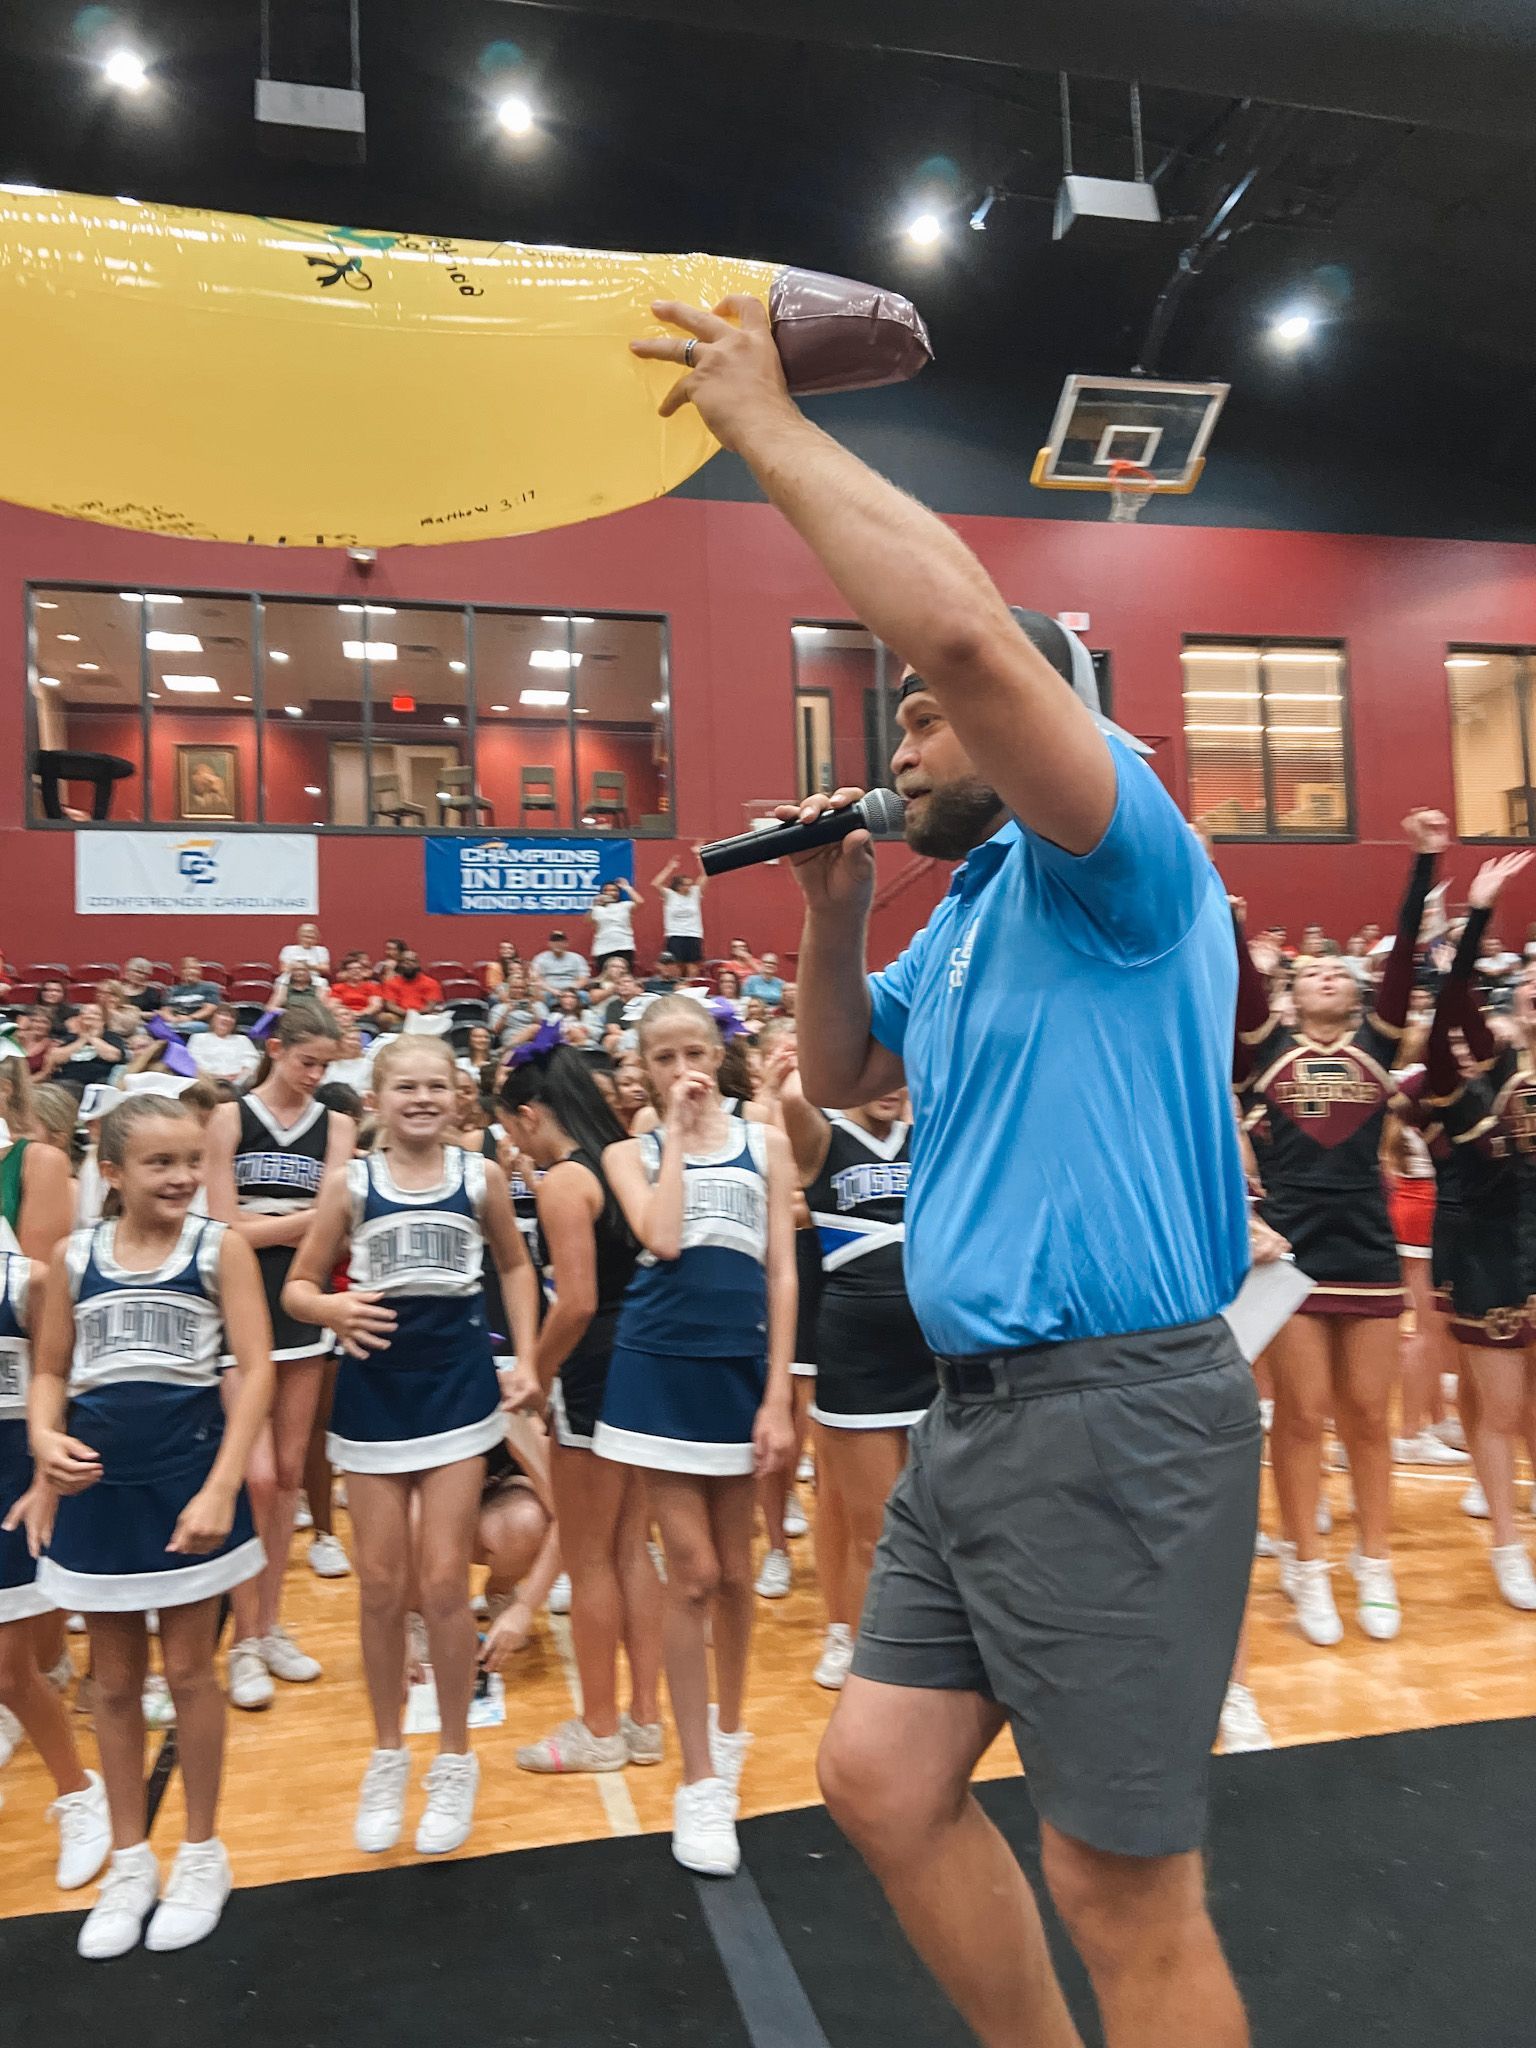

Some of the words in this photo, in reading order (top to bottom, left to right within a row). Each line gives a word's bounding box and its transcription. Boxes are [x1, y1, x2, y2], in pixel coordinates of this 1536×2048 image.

[460, 848, 600, 865] CHAMPIONS
[460, 868, 500, 890] IN
[87, 896, 206, 908] CONFERENCE
[209, 897, 308, 909] CAROLINAS
[461, 895, 521, 910] MIND
